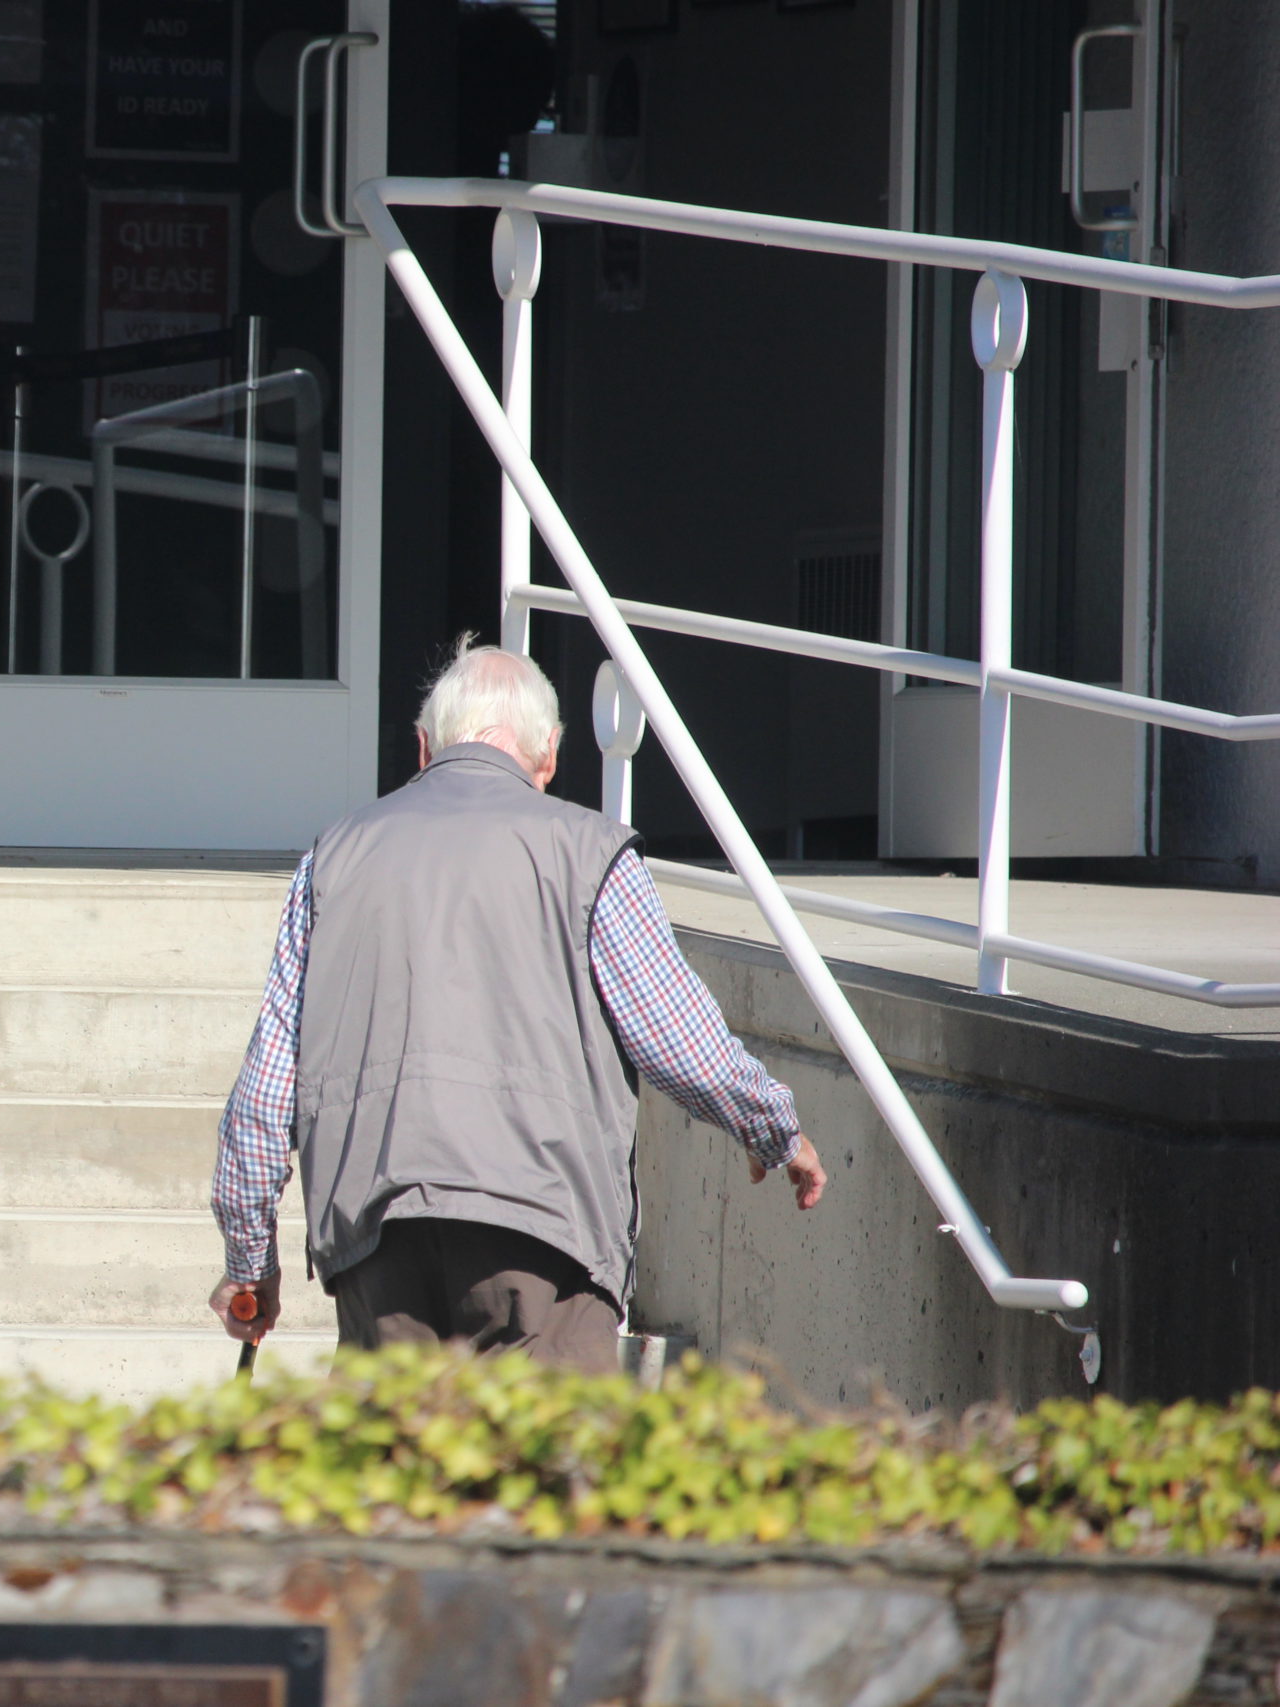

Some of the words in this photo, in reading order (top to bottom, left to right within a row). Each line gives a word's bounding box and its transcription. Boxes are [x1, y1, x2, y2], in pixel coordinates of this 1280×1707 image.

[144, 18, 188, 36] AND
[108, 56, 161, 74] HAVE
[168, 57, 225, 77] YOUR
[117, 95, 138, 113] ID
[143, 96, 209, 116] READY
[120, 221, 210, 251] QUIET
[110, 265, 217, 294] PLEASE
